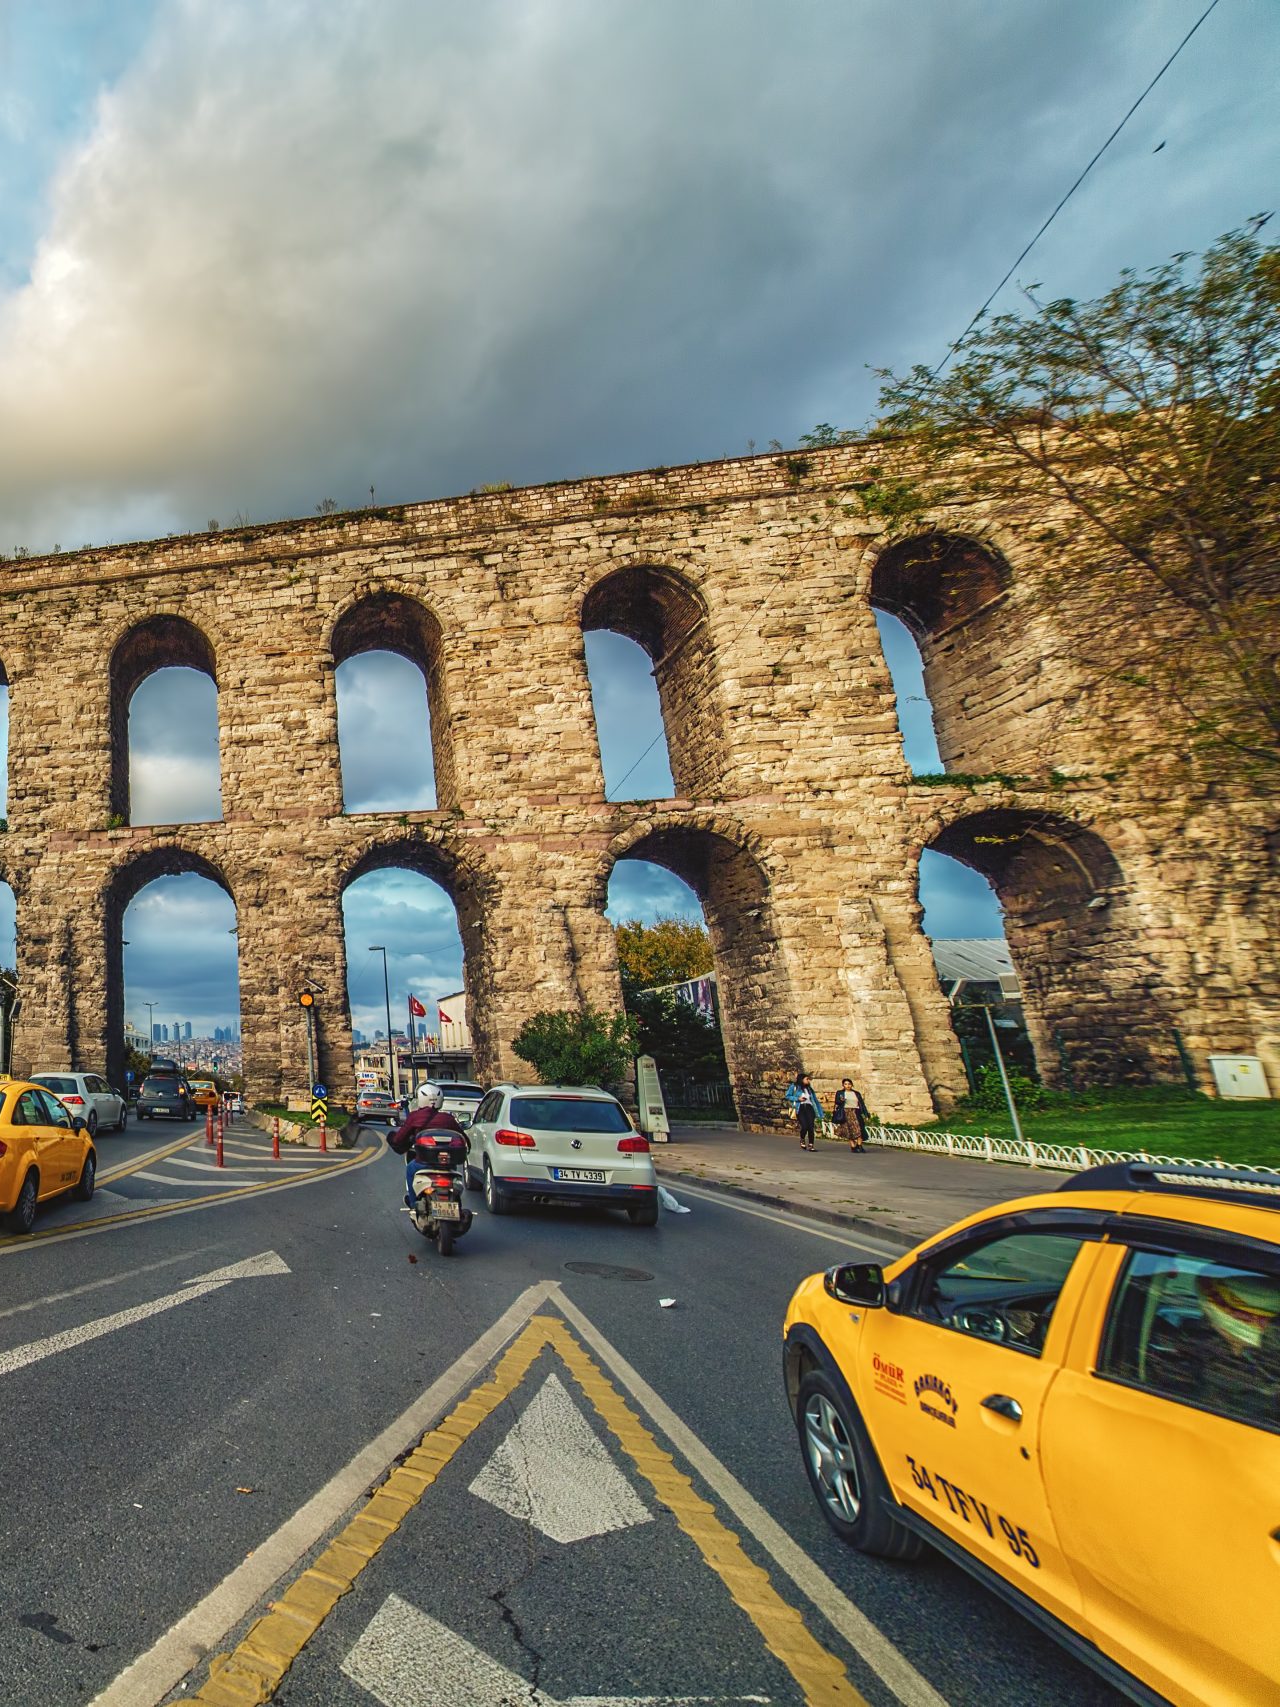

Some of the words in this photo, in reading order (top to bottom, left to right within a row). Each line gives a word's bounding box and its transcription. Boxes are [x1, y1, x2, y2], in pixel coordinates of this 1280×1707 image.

[558, 1169, 569, 1179] 34
[571, 1170, 581, 1180] TV
[584, 1171, 603, 1181] 4339
[905, 1454, 939, 1501] 34
[934, 1472, 995, 1540] TFV
[997, 1515, 1040, 1568] 95
